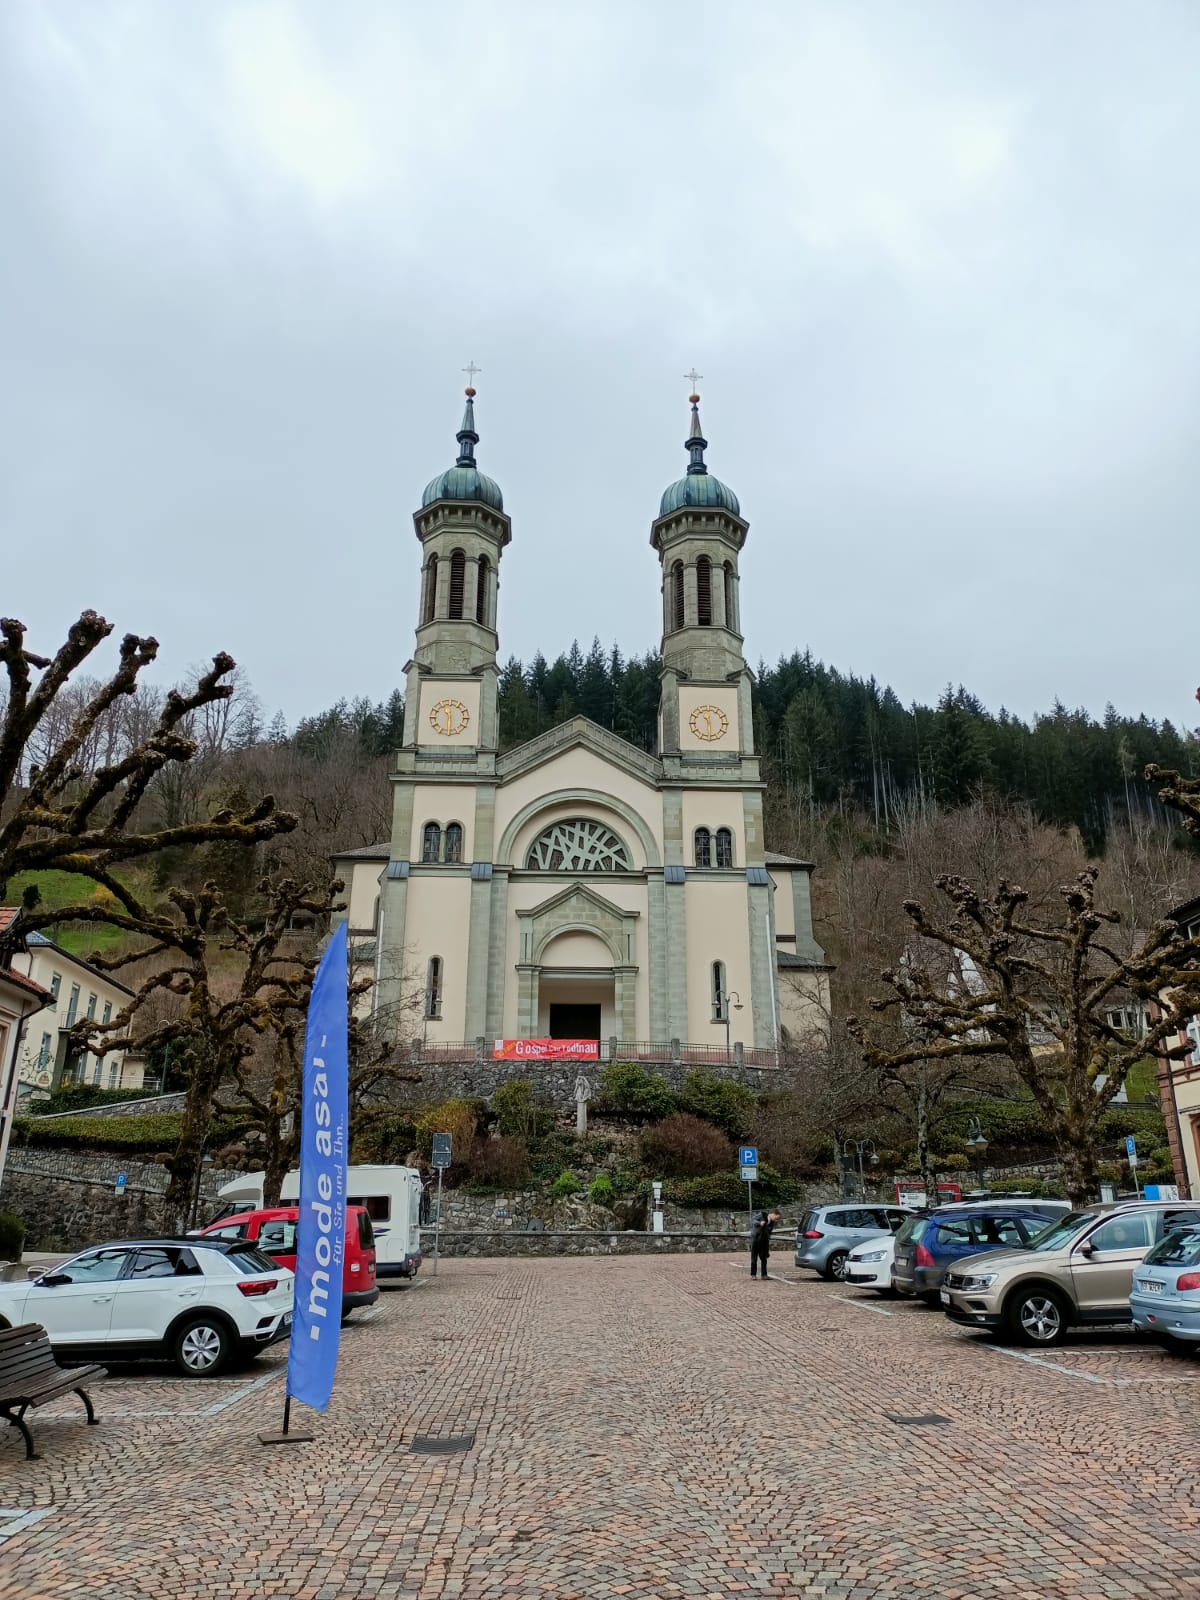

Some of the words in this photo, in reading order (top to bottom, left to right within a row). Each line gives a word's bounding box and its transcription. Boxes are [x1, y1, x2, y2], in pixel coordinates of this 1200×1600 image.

[744, 1150, 752, 1163] P
[333, 1164, 344, 1195] und
[333, 1202, 344, 1229] Sie
[308, 1173, 332, 1318] mode
[332, 1236, 344, 1266] für
